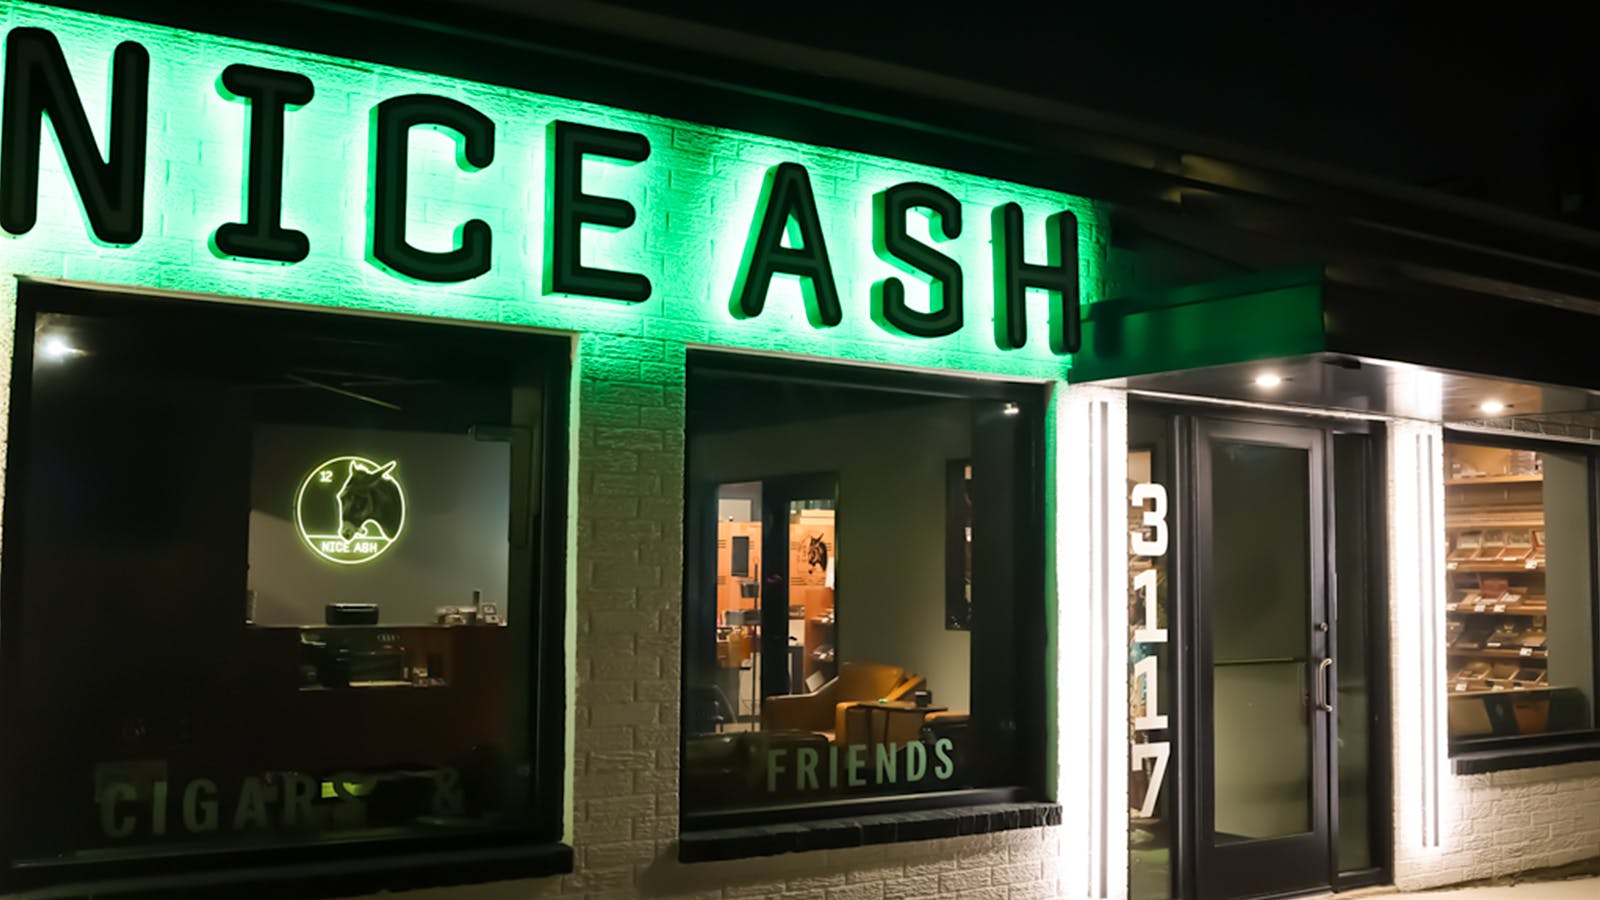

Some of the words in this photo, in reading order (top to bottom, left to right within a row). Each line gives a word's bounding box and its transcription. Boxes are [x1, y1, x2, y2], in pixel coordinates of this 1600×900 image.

[0, 27, 652, 303] NICE
[729, 162, 1081, 355] ASH
[319, 470, 333, 482] 12
[321, 541, 350, 553] NICE
[353, 542, 378, 553] ASH
[1131, 483, 1170, 818] 3117
[432, 766, 465, 815] &
[766, 738, 955, 793] FRIENDS
